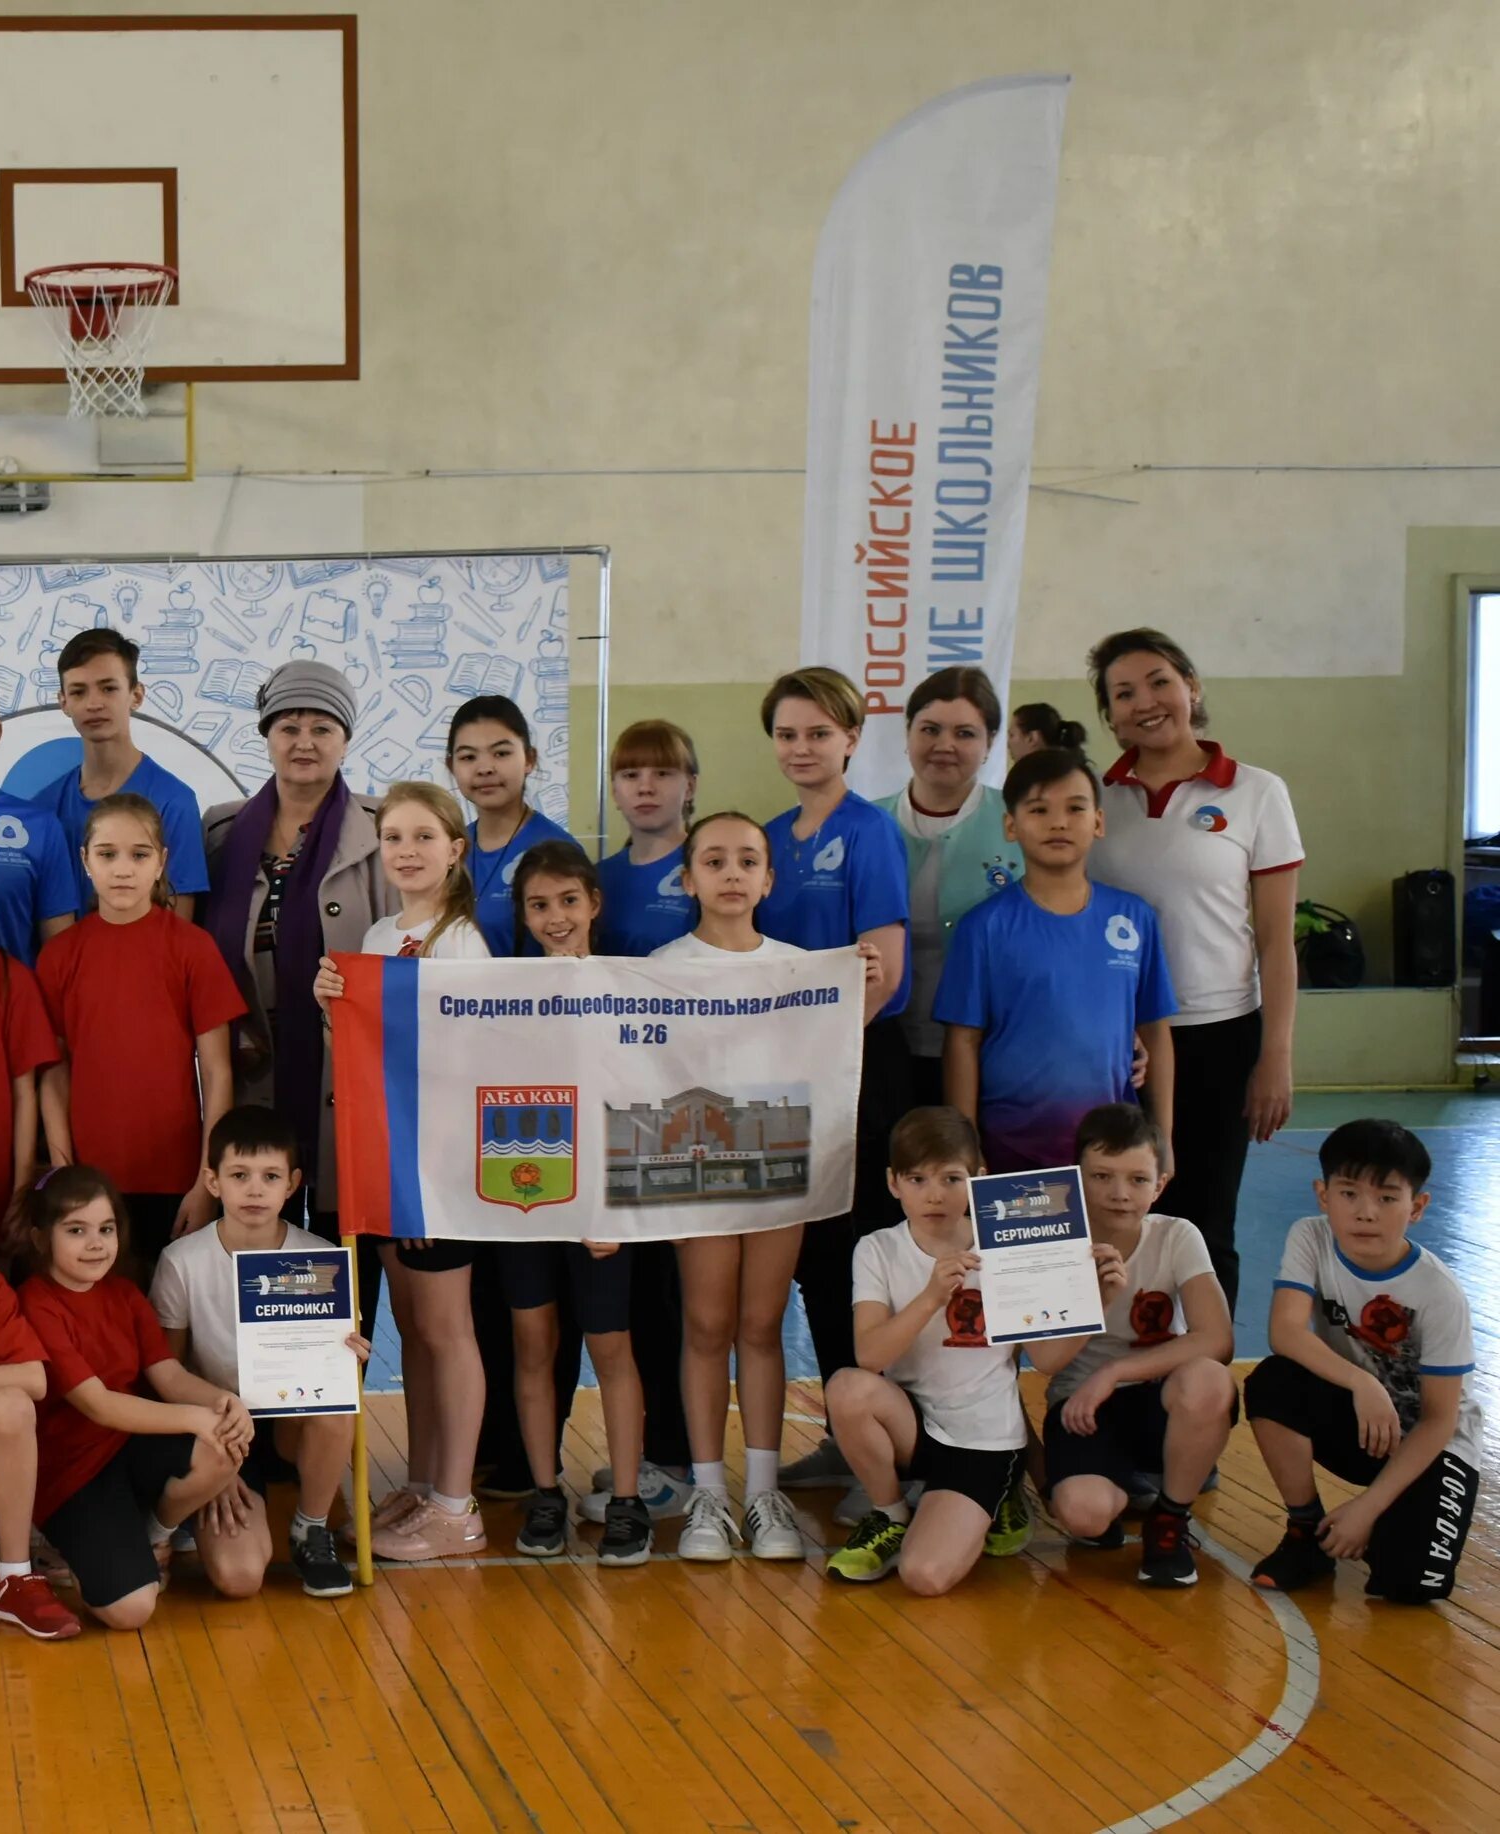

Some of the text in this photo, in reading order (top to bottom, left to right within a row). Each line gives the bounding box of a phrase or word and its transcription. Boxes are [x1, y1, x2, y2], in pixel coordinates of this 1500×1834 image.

[926, 263, 1005, 673] ИЕ ШКОЛЬНИКОВ
[854, 418, 917, 715] РОССИЙСКОЕ
[440, 986, 840, 1018] Средняя общеобразовательная школа
[619, 1023, 668, 1045] № 26
[483, 1091, 571, 1105] АБАКАН
[993, 1222, 1071, 1243] СЕРТИФИКАТ
[255, 1302, 335, 1317] СЕРТИФИКАТ
[1420, 1457, 1466, 1587] JORDAN
